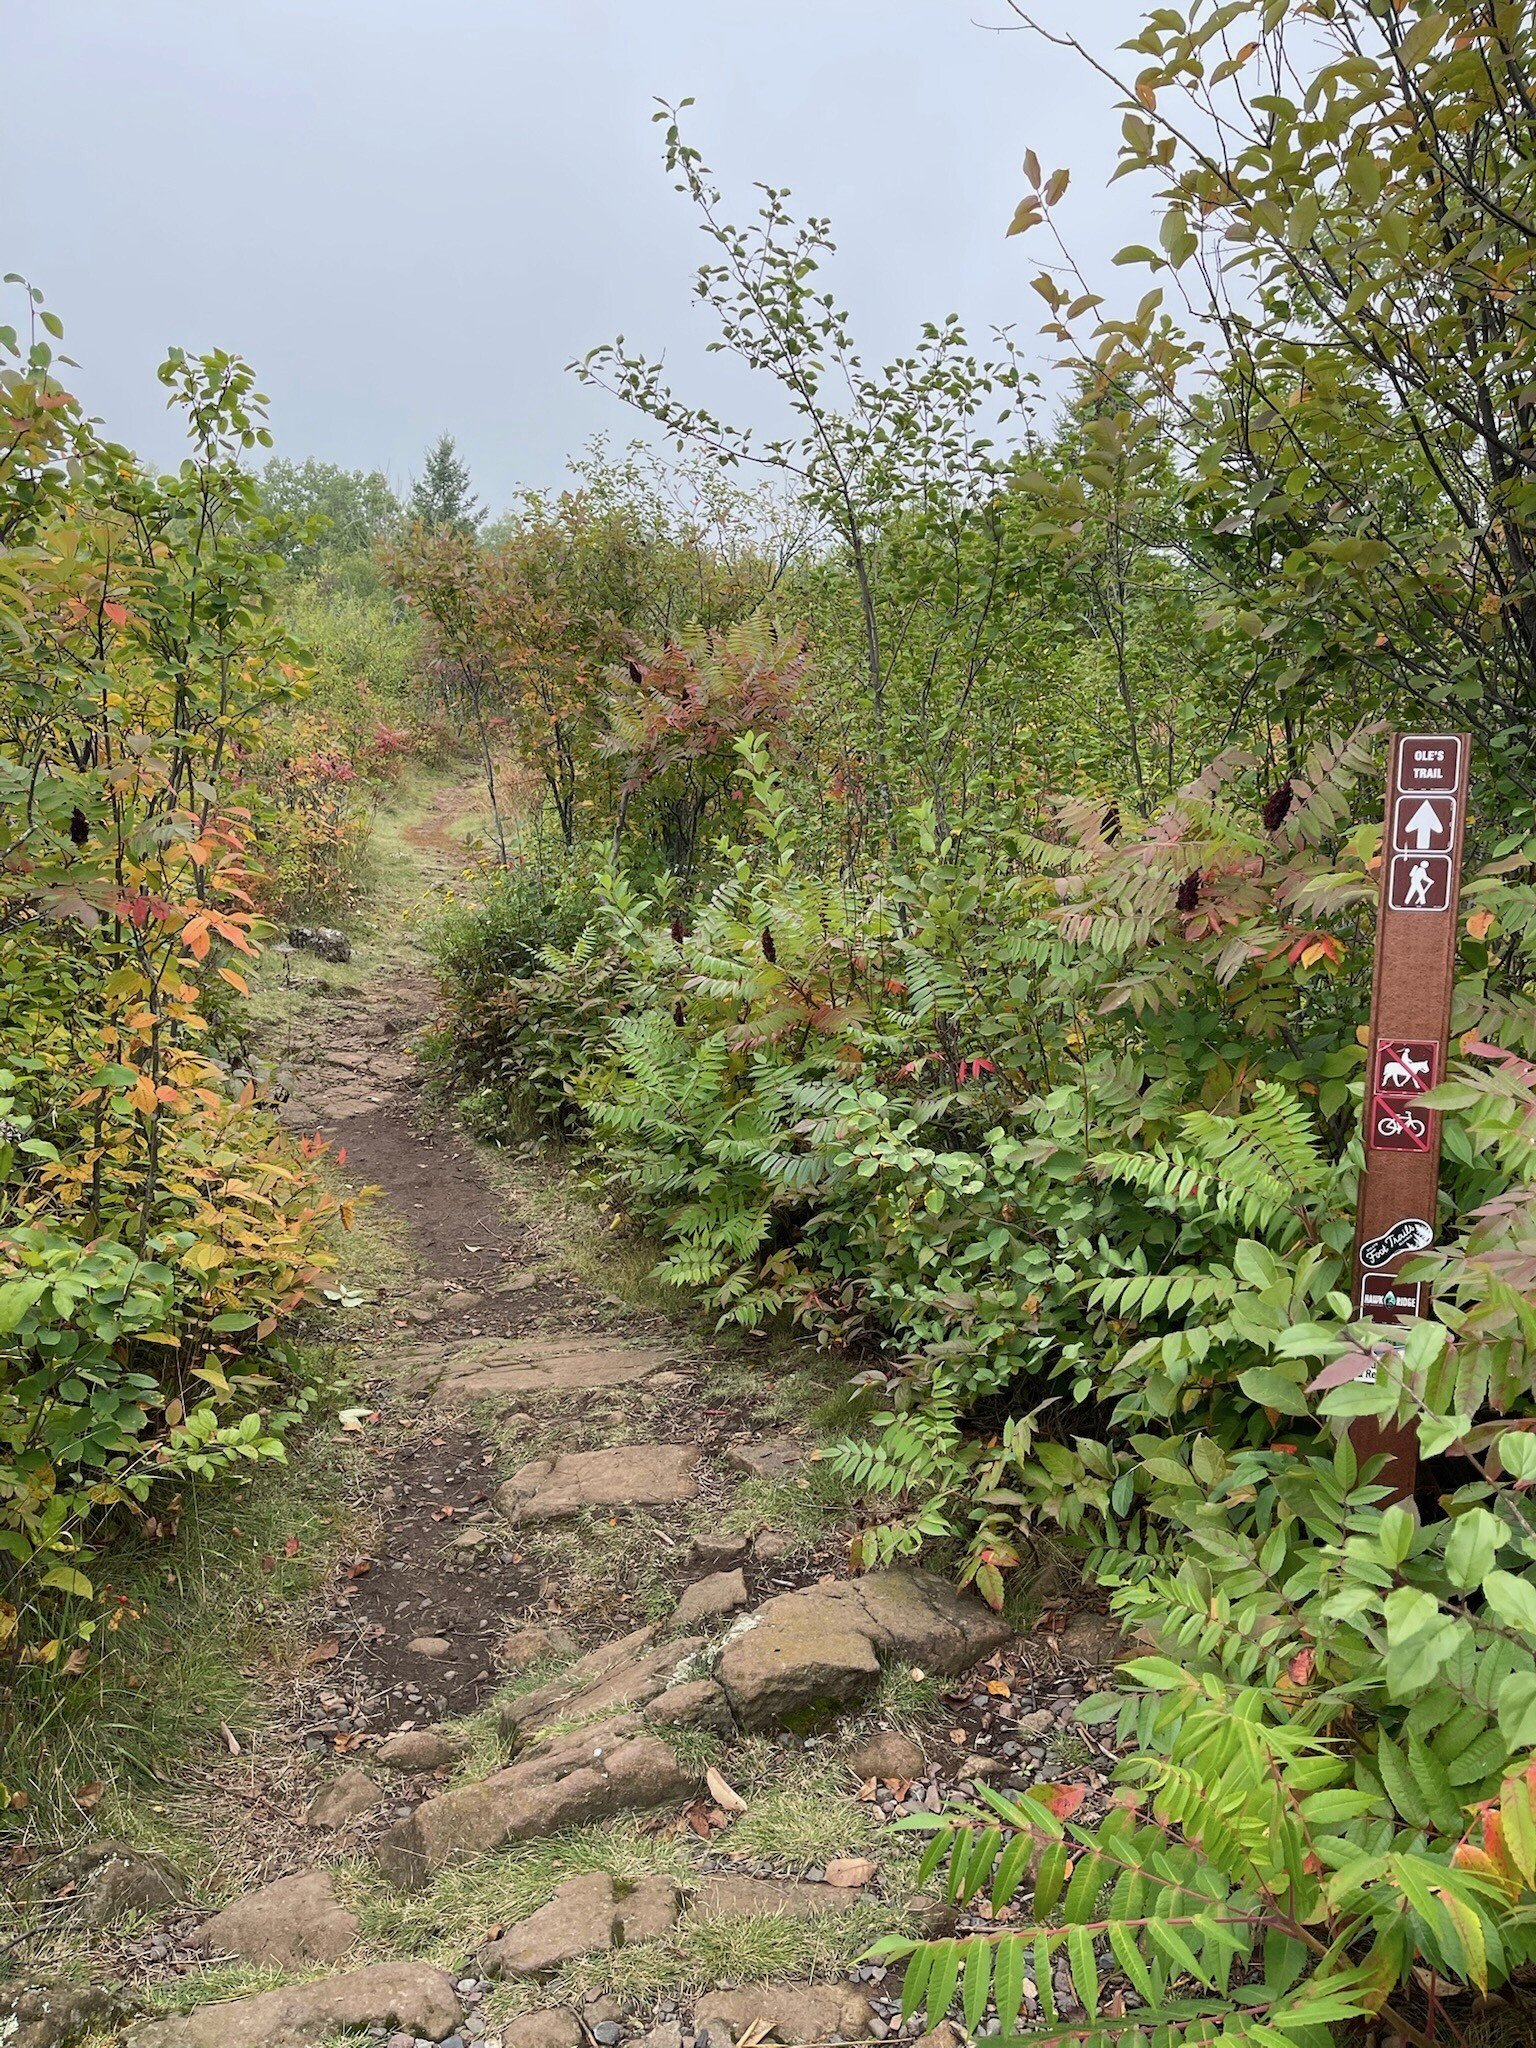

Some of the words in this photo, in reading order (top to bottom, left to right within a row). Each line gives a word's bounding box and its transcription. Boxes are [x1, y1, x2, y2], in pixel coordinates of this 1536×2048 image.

[1414, 750, 1445, 761] OLE'S
[1413, 768, 1443, 778] TRAIL
[1366, 1244, 1389, 1264] Foot
[1385, 1224, 1415, 1248] Trails
[1364, 1294, 1384, 1304] HAWK
[1396, 1297, 1416, 1307] RIDGE
